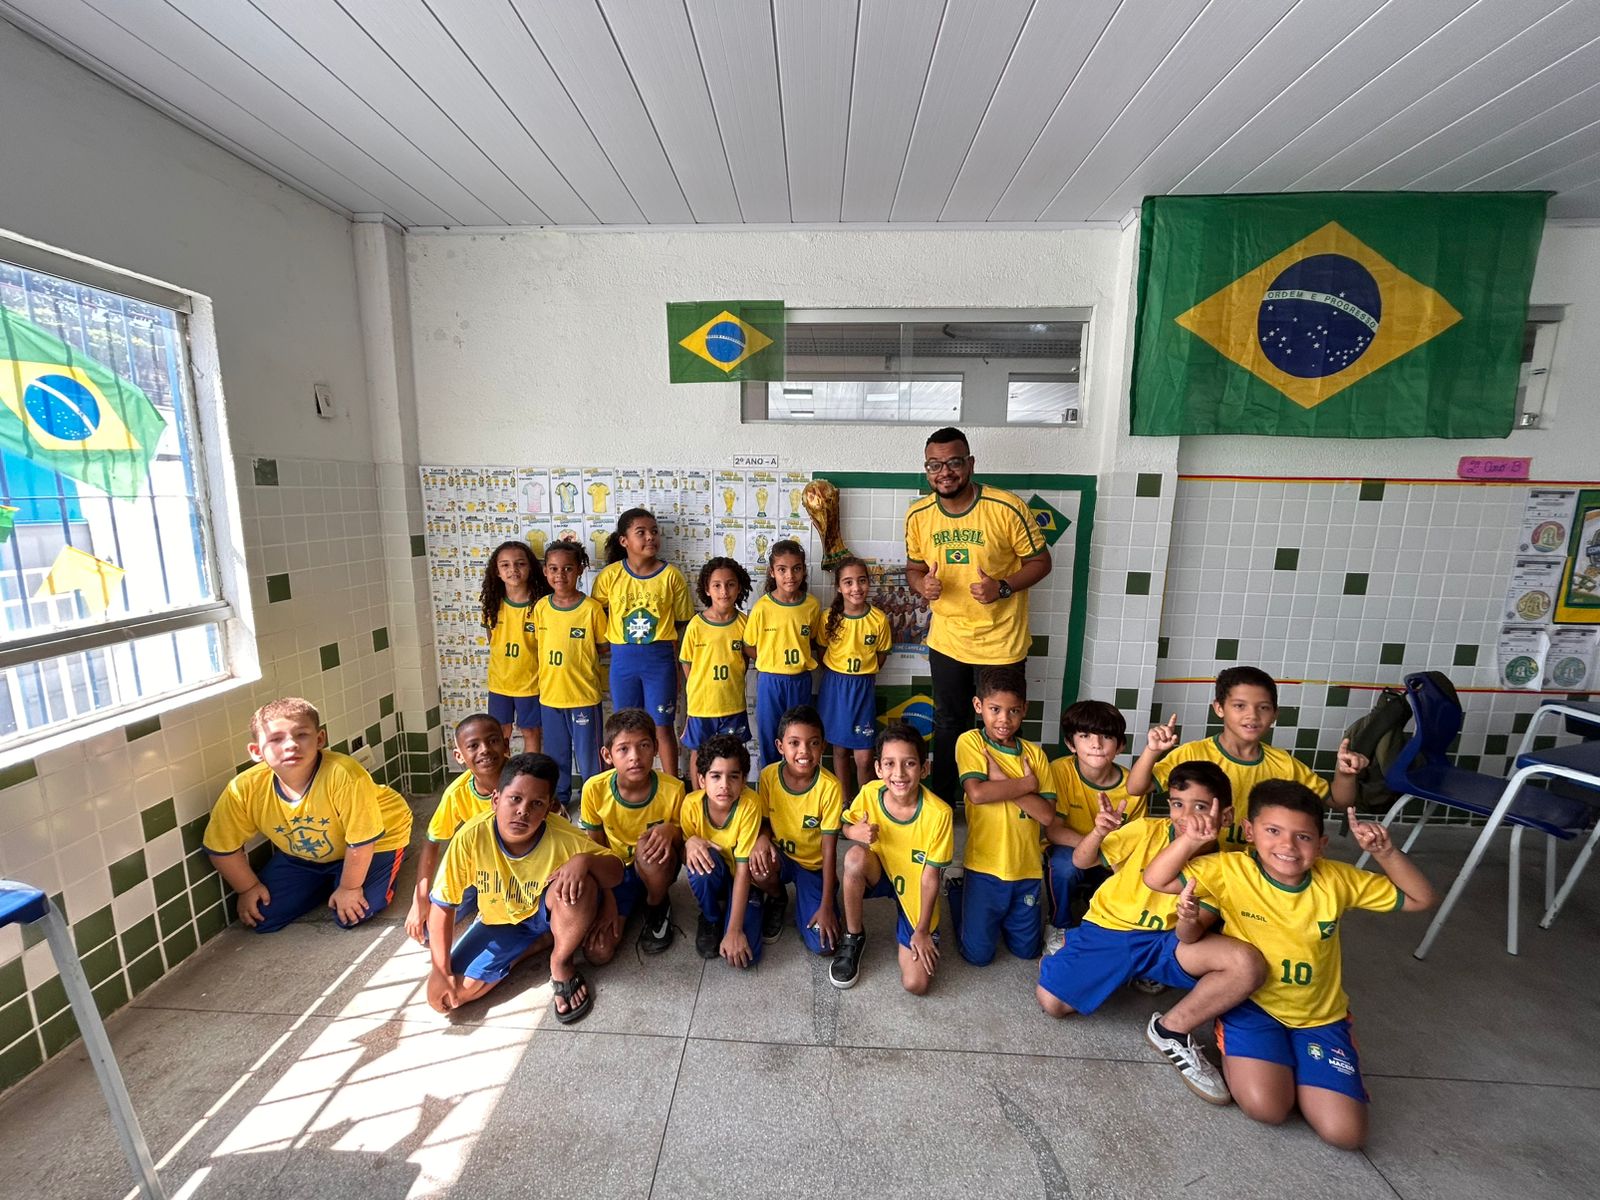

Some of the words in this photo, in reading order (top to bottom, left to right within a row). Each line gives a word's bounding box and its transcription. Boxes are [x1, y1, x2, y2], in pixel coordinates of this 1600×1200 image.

[1267, 290, 1304, 299] ORDEM
[1323, 295, 1377, 330] PROGRESSO
[745, 457, 764, 466] ANO
[770, 457, 777, 465] A
[933, 528, 986, 547] BRASIL
[505, 642, 520, 658] 10
[549, 650, 563, 666] 10
[784, 649, 799, 665] 10
[713, 665, 728, 681] 10
[846, 658, 861, 673] 10
[1138, 909, 1165, 930] 10
[1241, 911, 1268, 923] BRASIL
[1281, 959, 1313, 985] 10
